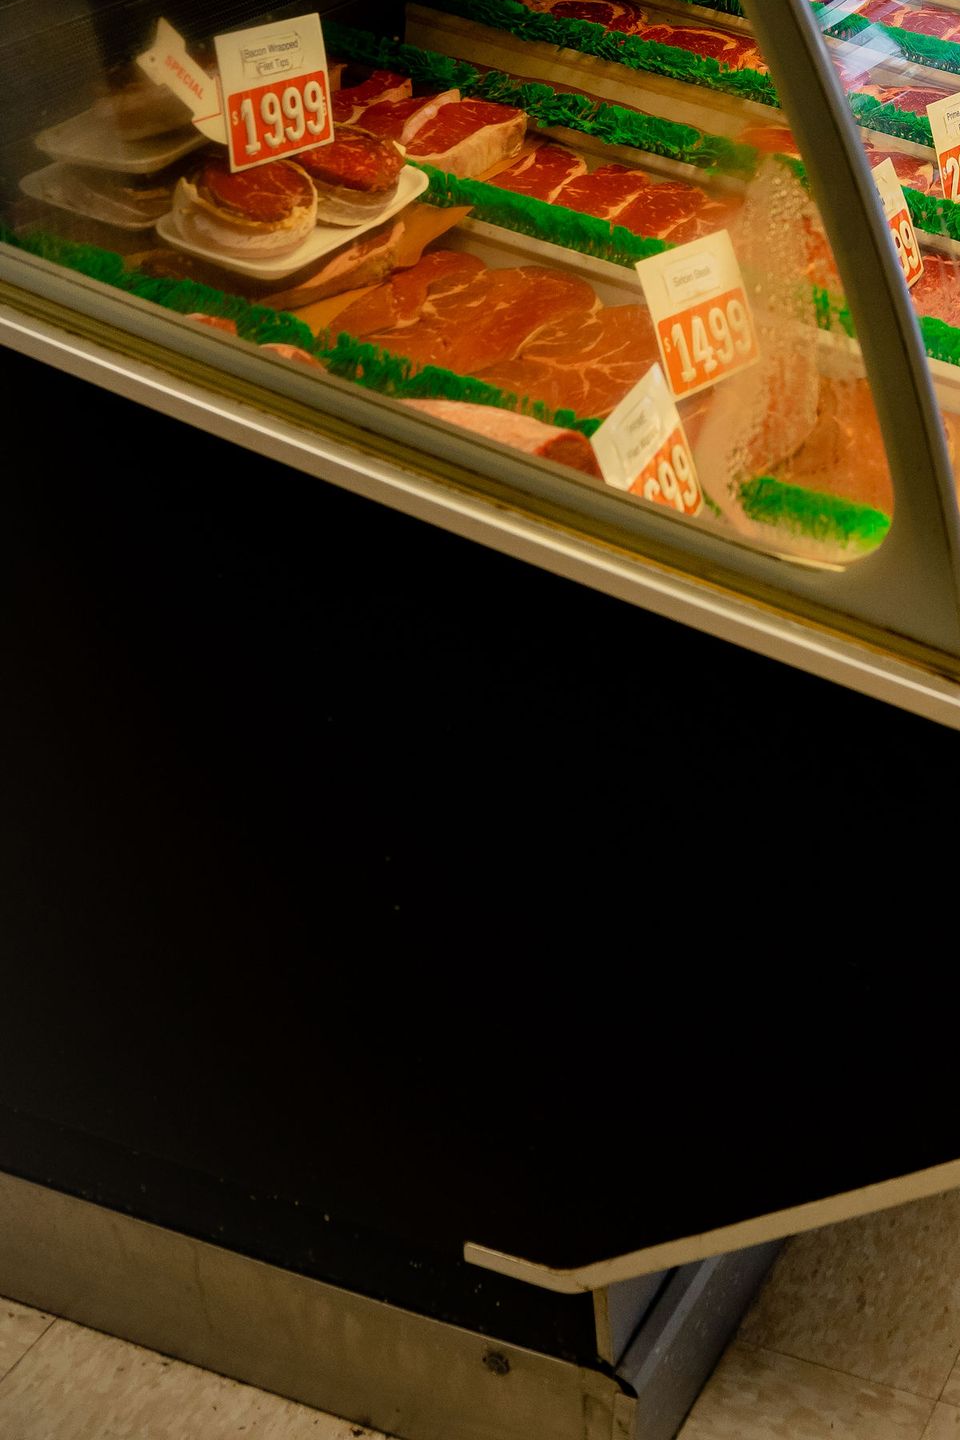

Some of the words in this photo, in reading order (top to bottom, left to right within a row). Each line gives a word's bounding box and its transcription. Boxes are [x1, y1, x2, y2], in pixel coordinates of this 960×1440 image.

[243, 47, 267, 58] Bacon
[267, 40, 298, 52] Wrapped
[164, 55, 204, 100] SPECIAL
[946, 108, 960, 120] Prime
